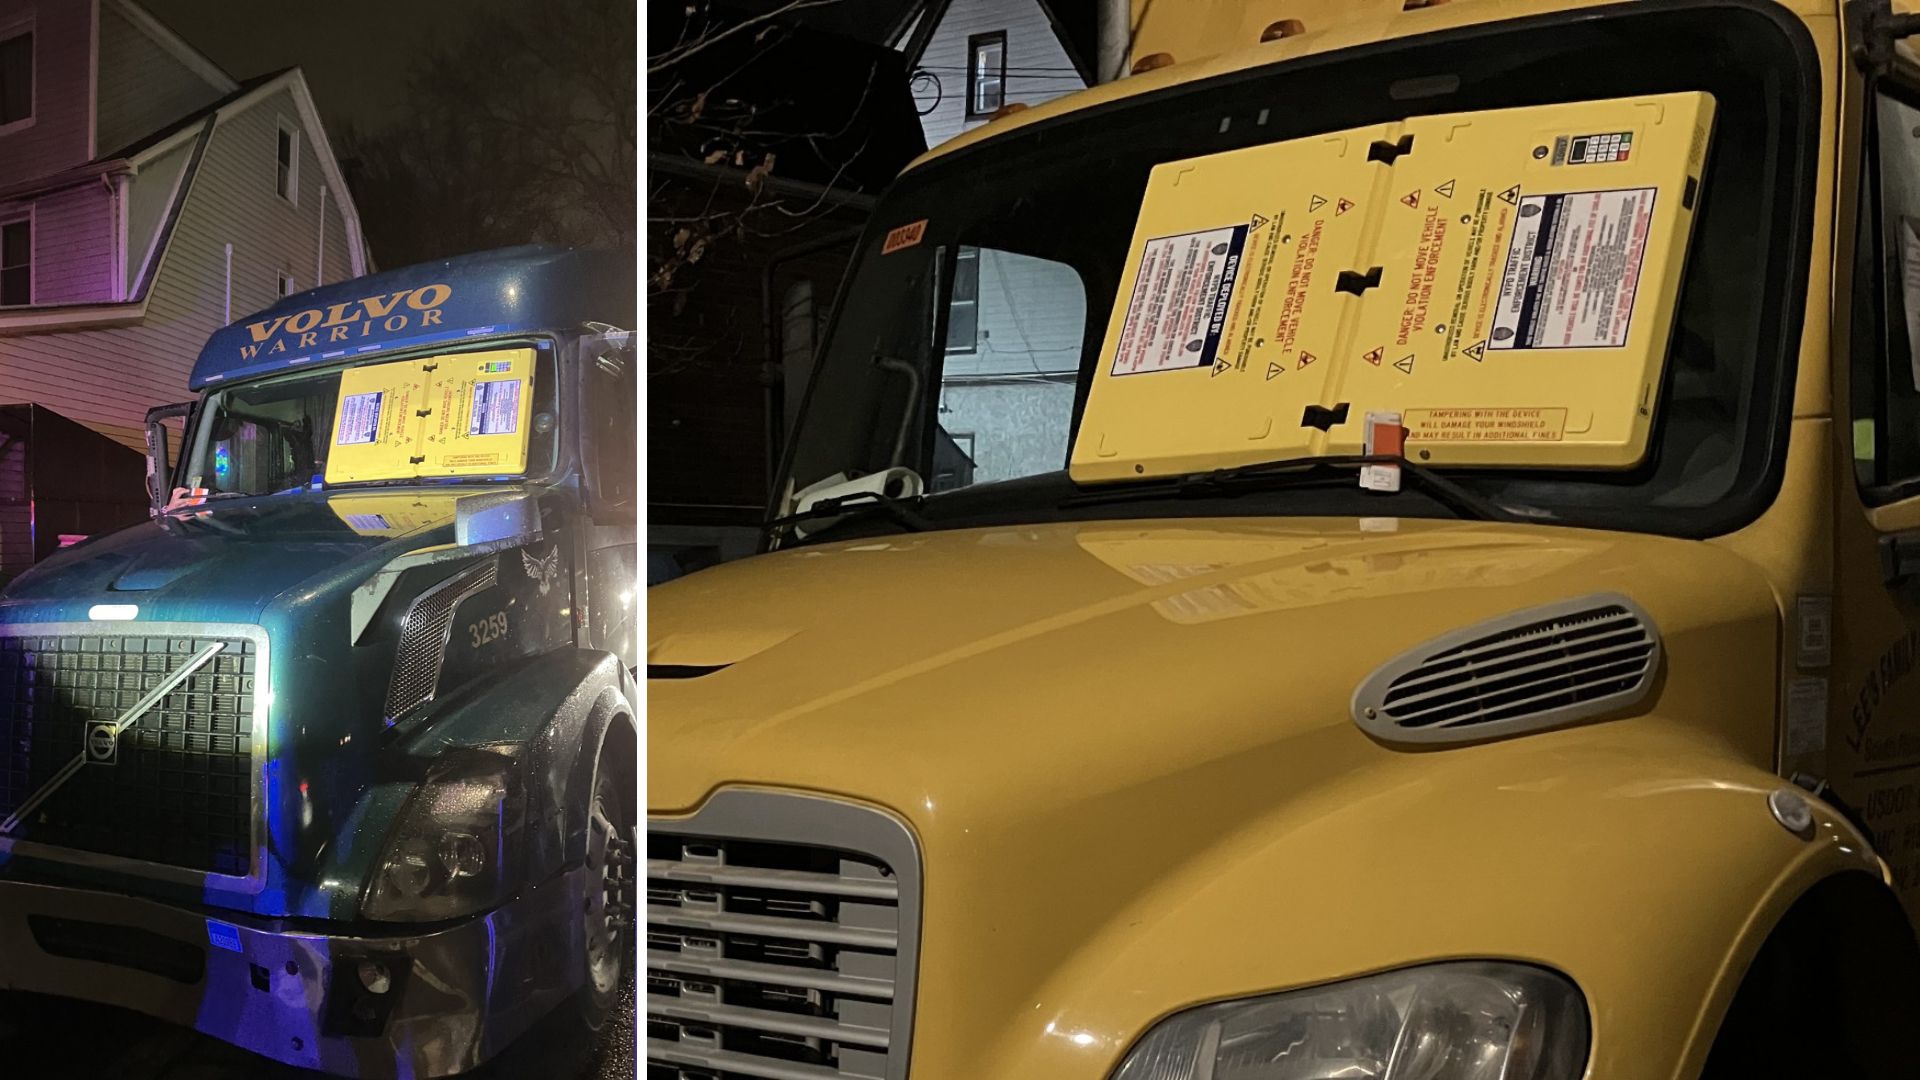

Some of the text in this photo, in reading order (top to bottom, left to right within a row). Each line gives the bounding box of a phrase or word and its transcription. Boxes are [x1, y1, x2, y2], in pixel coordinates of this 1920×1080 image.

[1197, 260, 1215, 305] ENFORCEMENT
[1202, 274, 1220, 318] NYPD TRAFFIC
[1209, 255, 1238, 336] DEVICE DEPLOYED BY:
[1274, 234, 1310, 342] VIOLATION ENFORCEMENT
[1281, 219, 1324, 354] DANGER: DO NOT MOVE VEHICLE
[1395, 206, 1438, 344] DANGER: DO NOT MOVE VEHICLE
[1411, 217, 1448, 330] VIOLATION ENFORCEMENT
[1502, 247, 1521, 295] NYPD TRAFFIC
[1510, 230, 1536, 312] ENFORCEMENT DISTRICT
[240, 309, 443, 360] WARRIOR
[246, 283, 452, 342] VOLVO
[1189, 306, 1203, 335] DISTRICT
[469, 611, 508, 648] 3259
